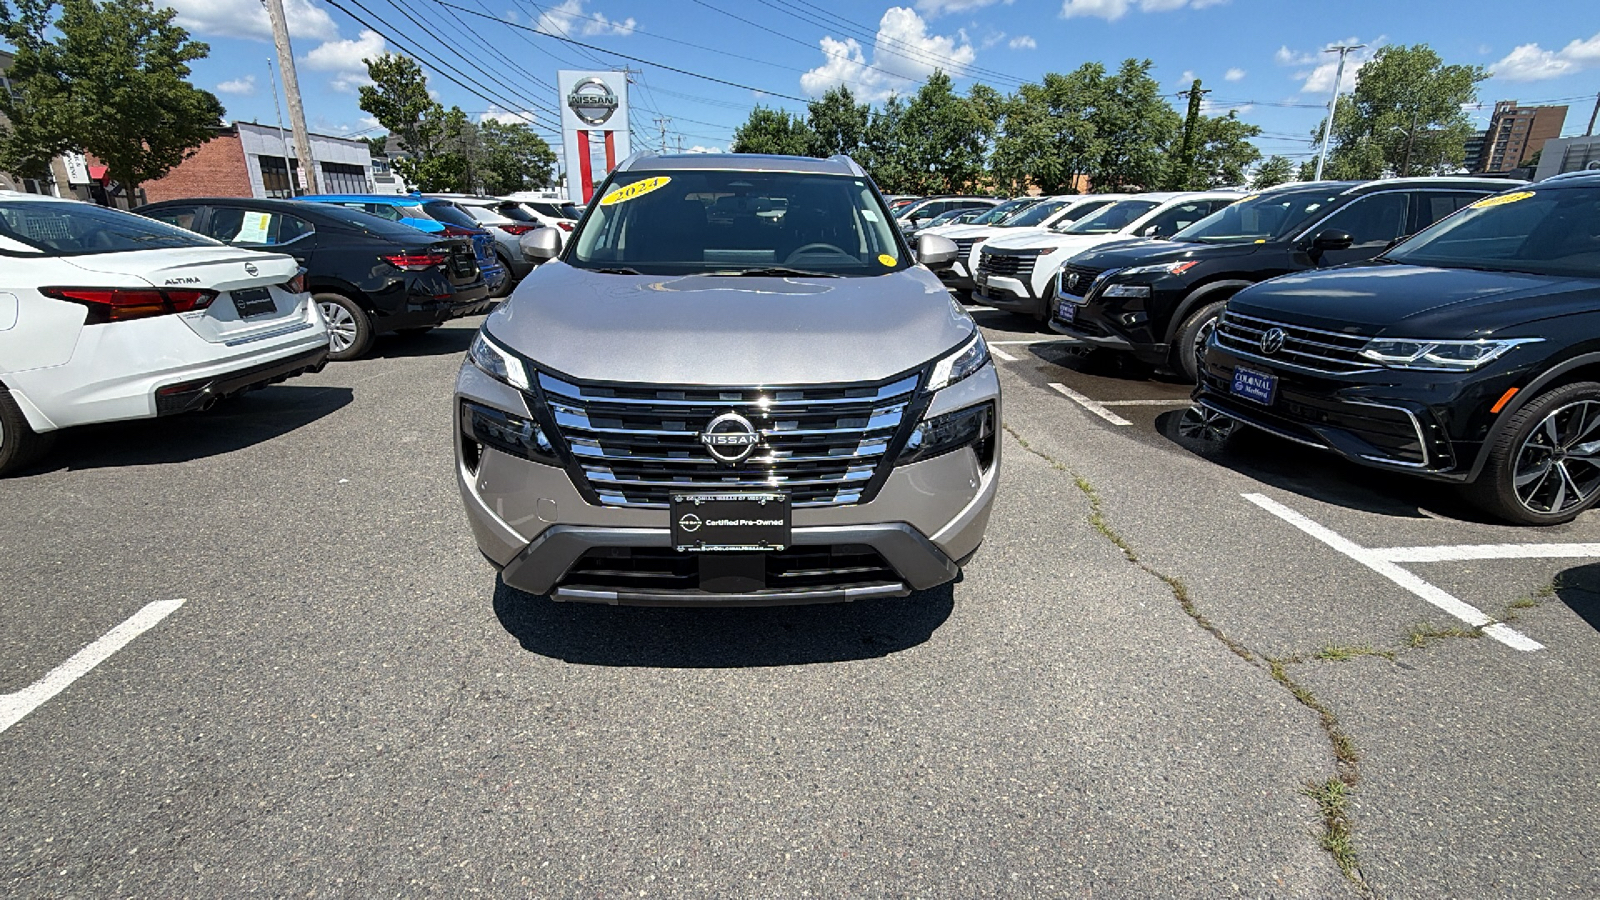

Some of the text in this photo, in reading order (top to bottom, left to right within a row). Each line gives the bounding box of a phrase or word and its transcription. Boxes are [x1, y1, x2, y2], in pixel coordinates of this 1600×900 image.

[572, 96, 613, 104] NISSAN
[614, 178, 659, 202] 2024
[164, 277, 201, 286] ALTIMA
[1235, 372, 1271, 391] COLONIAL
[1245, 385, 1268, 399] Medford
[701, 435, 759, 444] NISSAN
